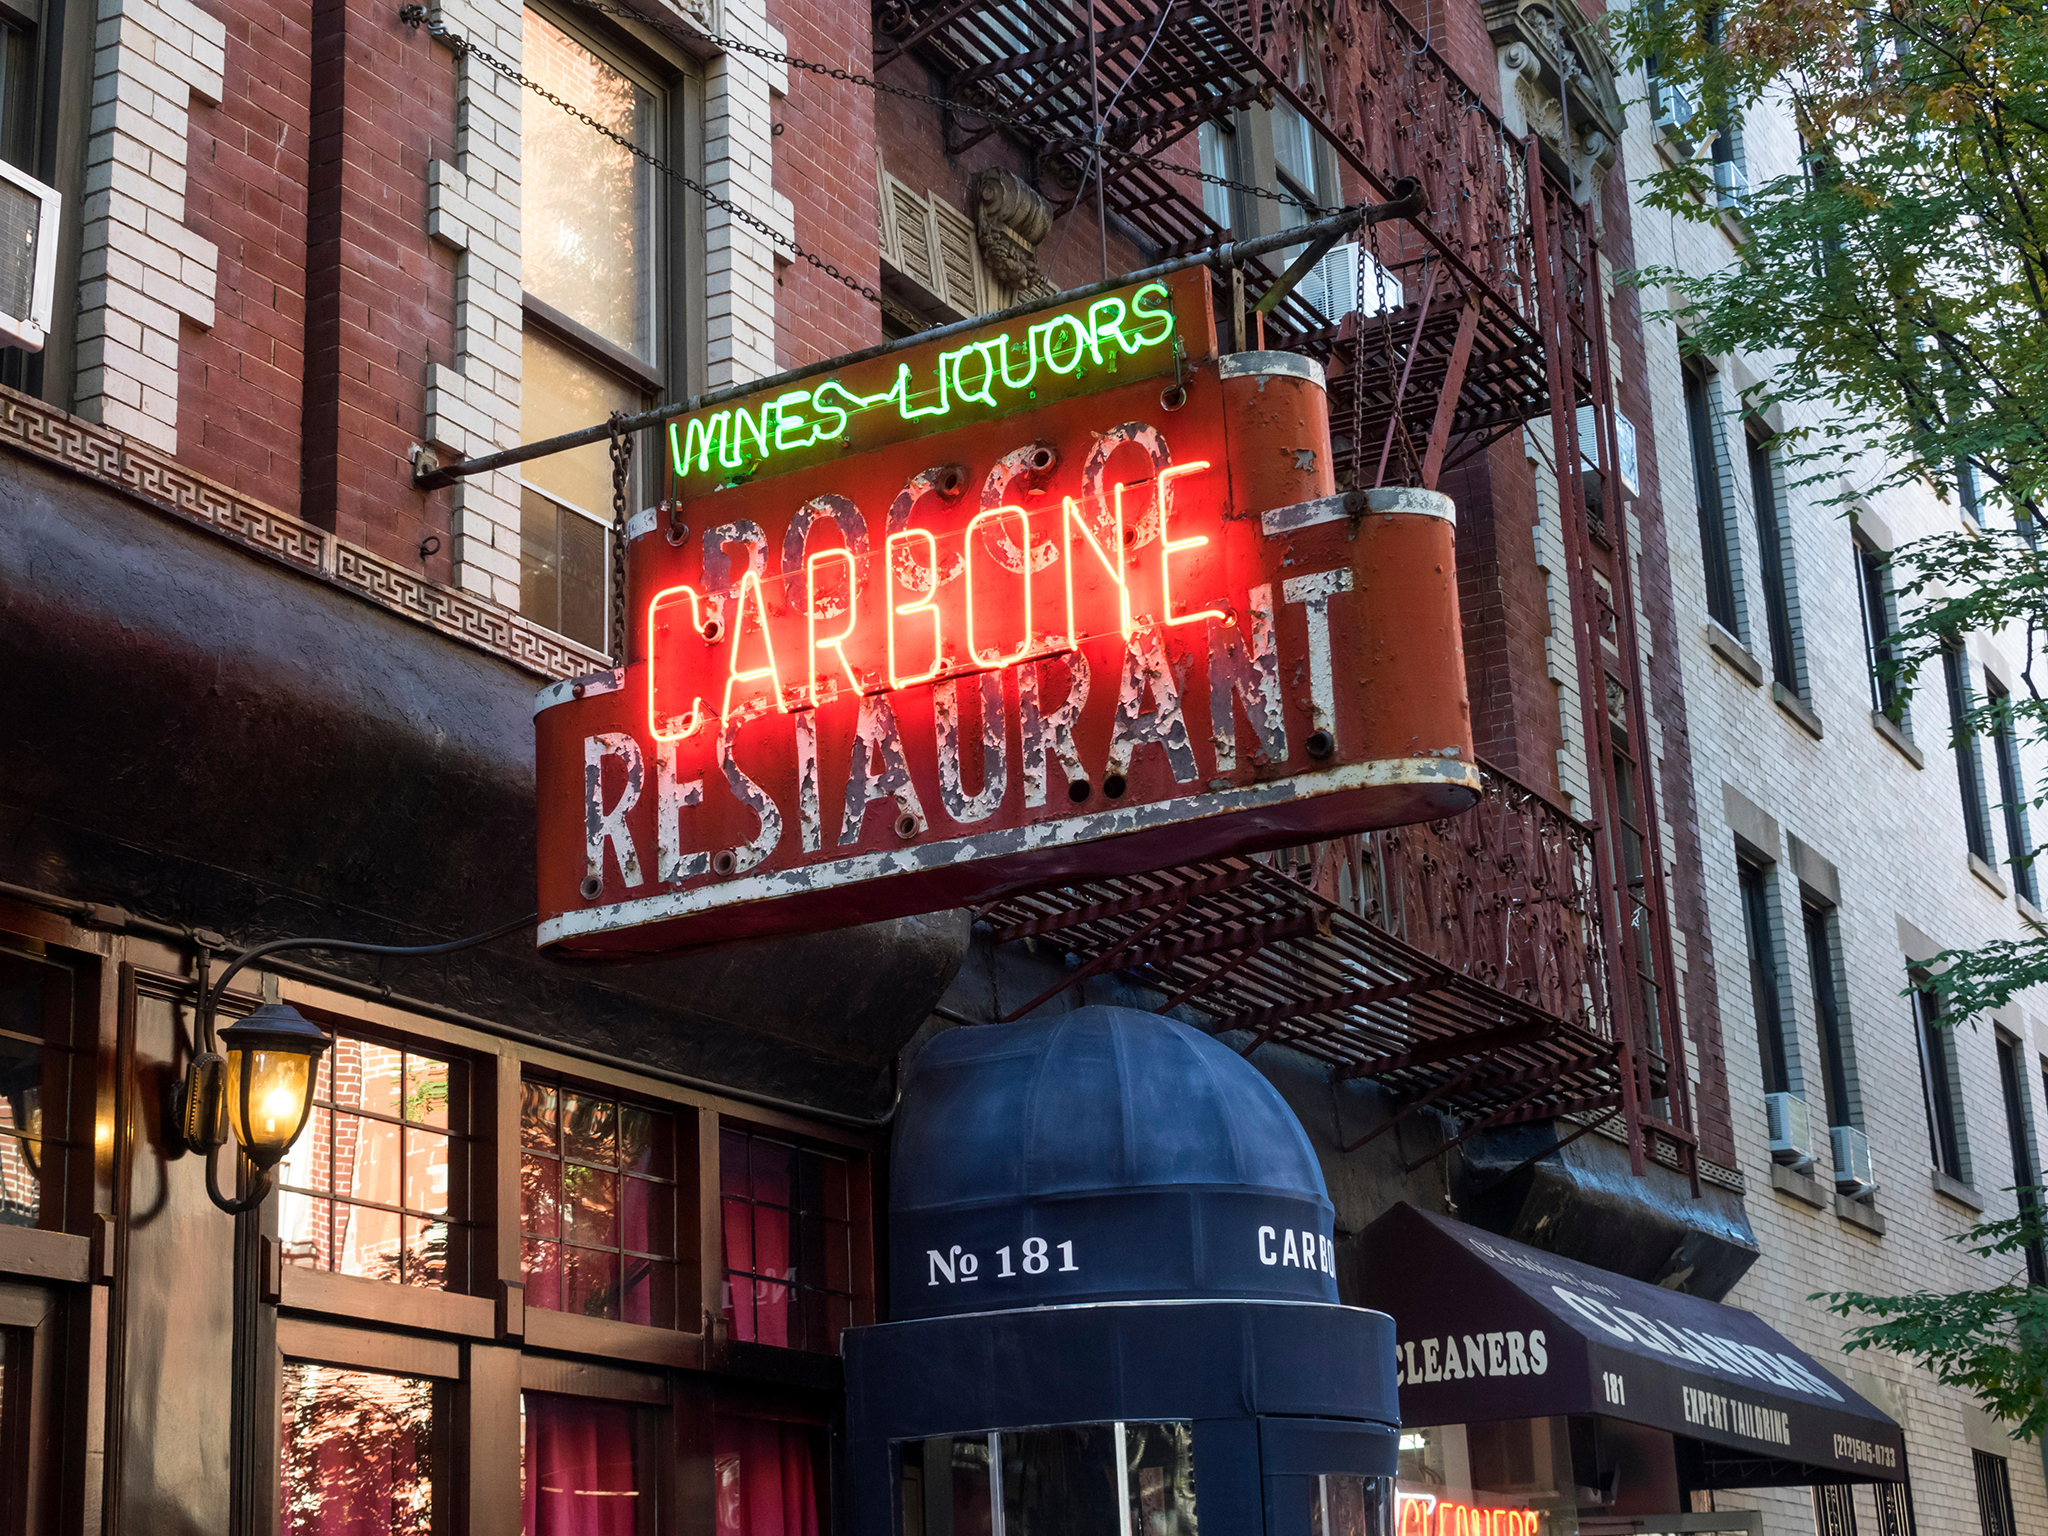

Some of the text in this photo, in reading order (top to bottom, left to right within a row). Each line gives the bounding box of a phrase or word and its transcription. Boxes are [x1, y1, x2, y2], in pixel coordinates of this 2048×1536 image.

[647, 460, 1232, 743] CARBONE
[583, 565, 1356, 892] RESTAURANT
[996, 1236, 1079, 1278] 181
[1258, 1225, 1336, 1280] CARBO
[1551, 1285, 1846, 1403] CLEANERS
[1602, 1371, 1626, 1406] 181
[1682, 1385, 1791, 1446] EXPERT TAILORING
[1833, 1433, 1896, 1468] (212)505-0733
